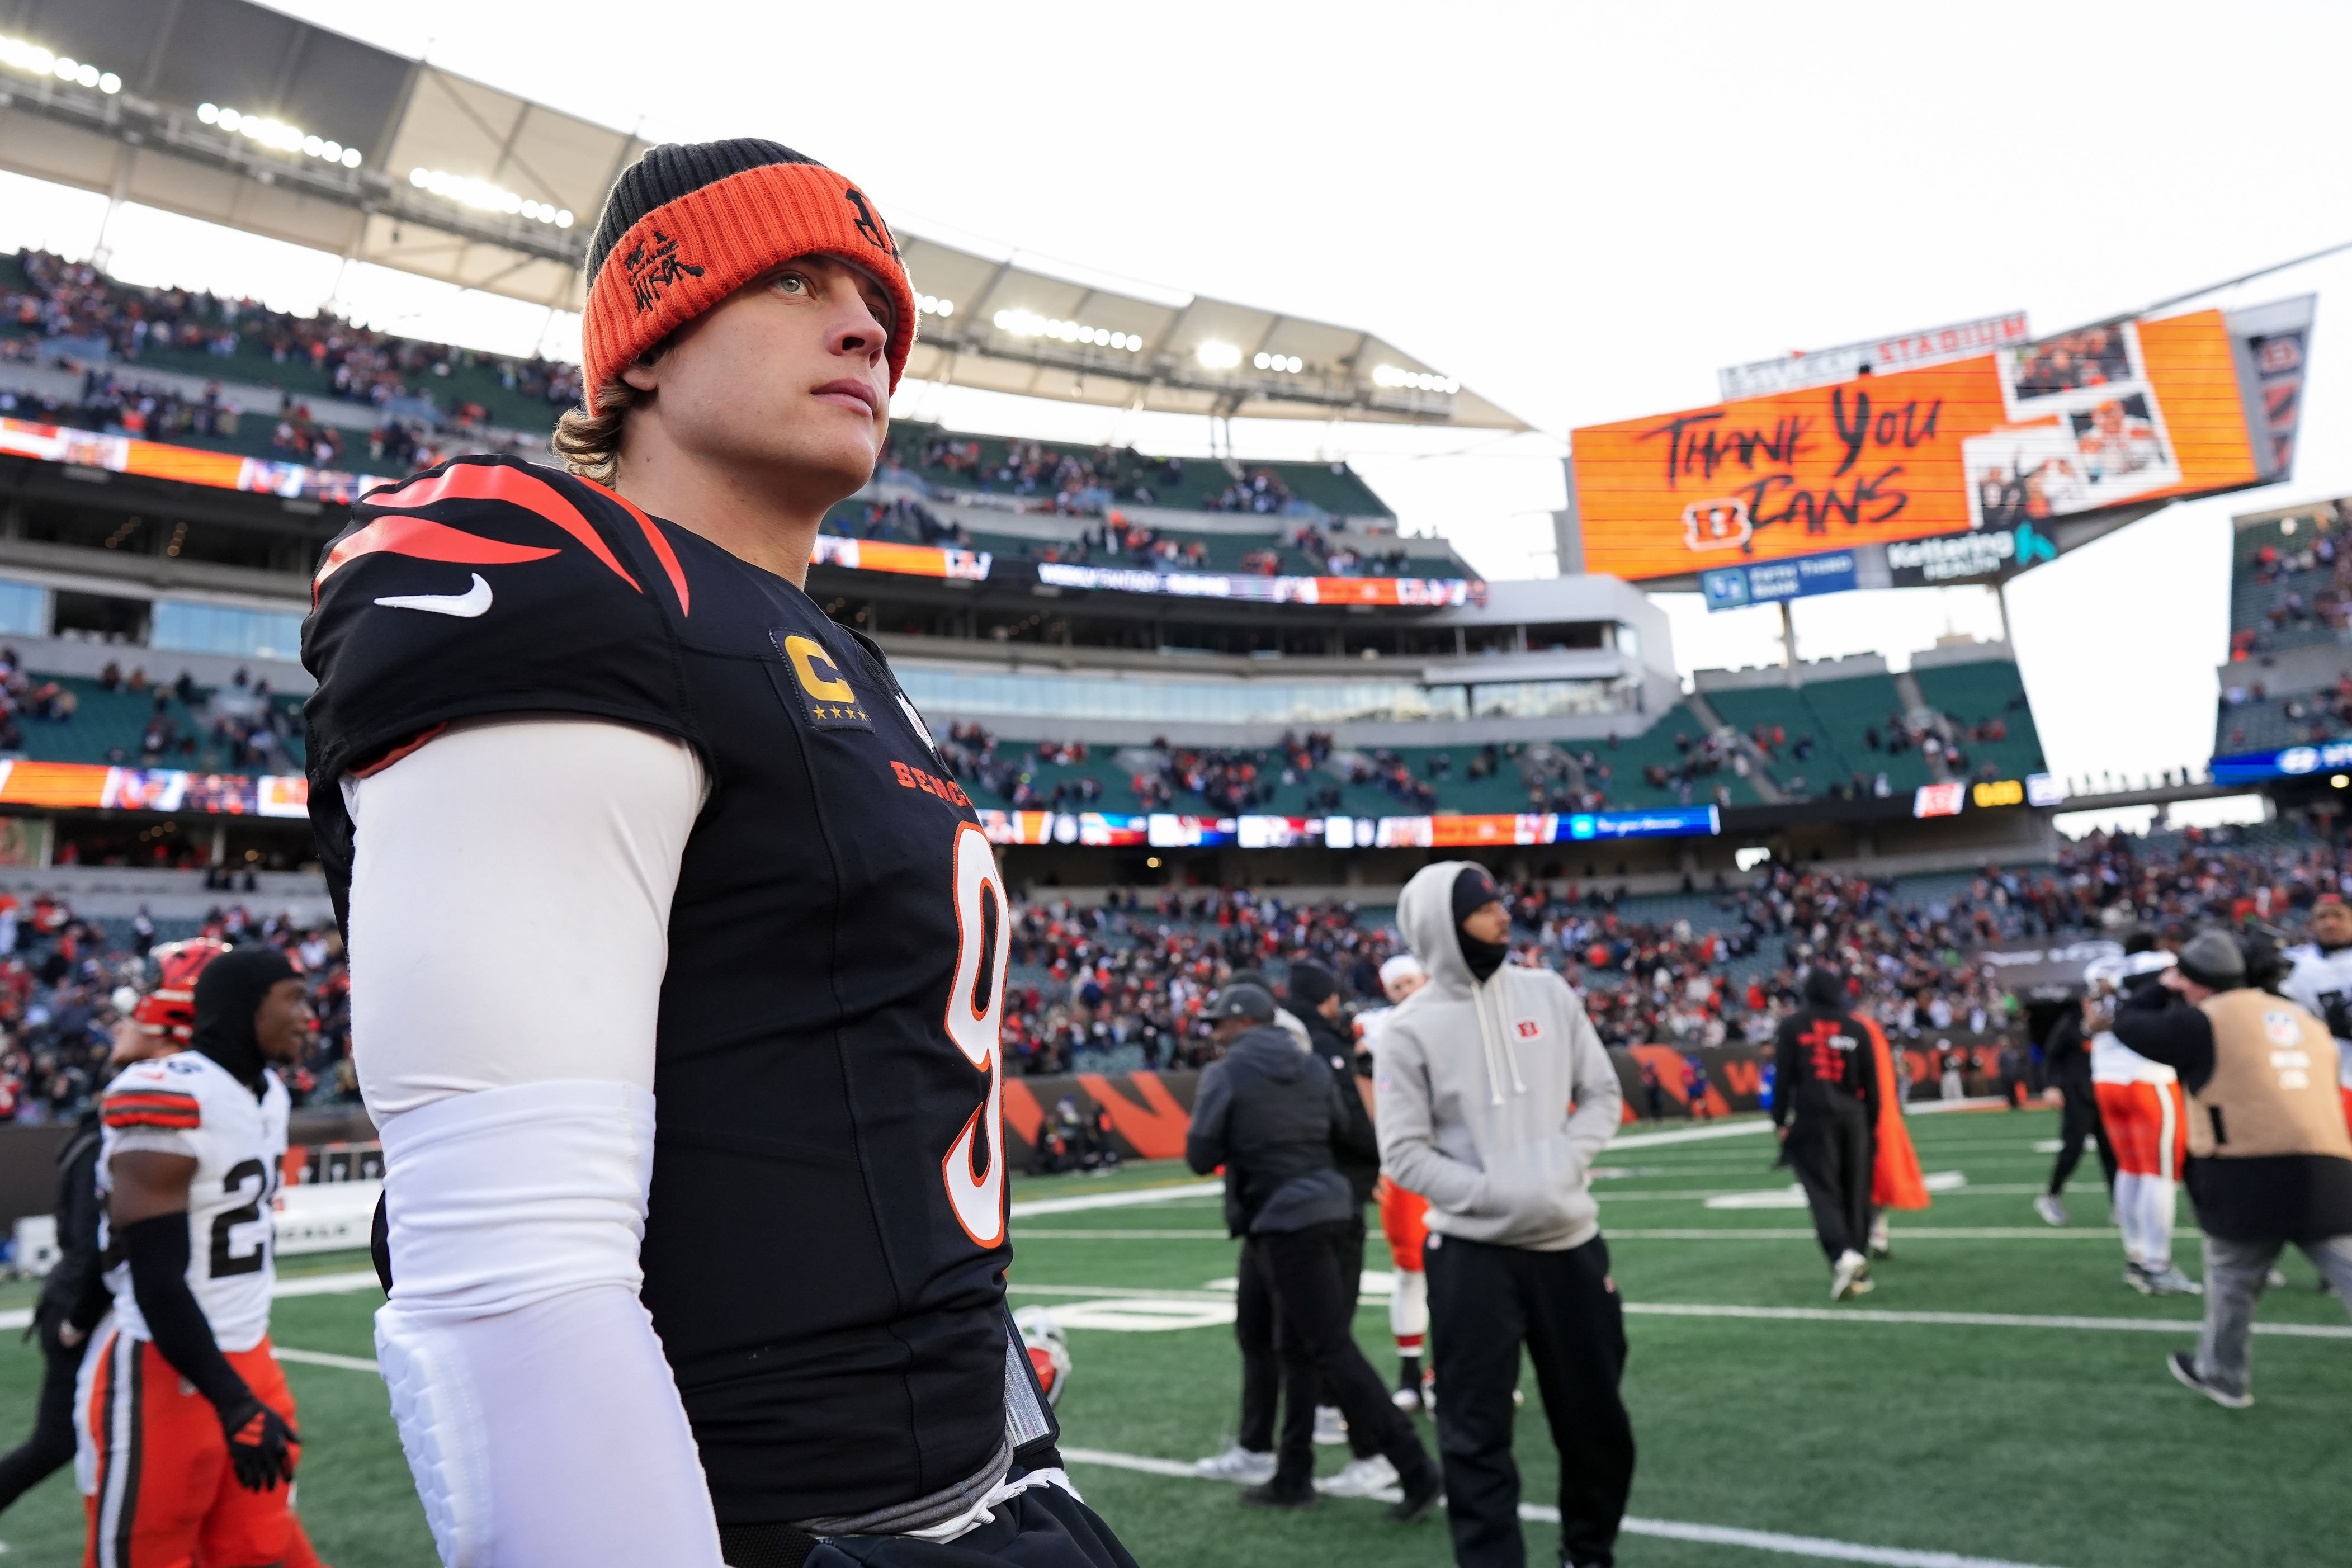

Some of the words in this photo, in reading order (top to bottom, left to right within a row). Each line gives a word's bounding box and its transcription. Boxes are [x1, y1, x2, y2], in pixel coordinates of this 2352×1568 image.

[1878, 314, 2025, 365] STADIUM
[1636, 411, 1820, 490] THANK
[785, 635, 855, 703] C
[890, 761, 974, 807] BENG
[942, 820, 1011, 1249] 9
